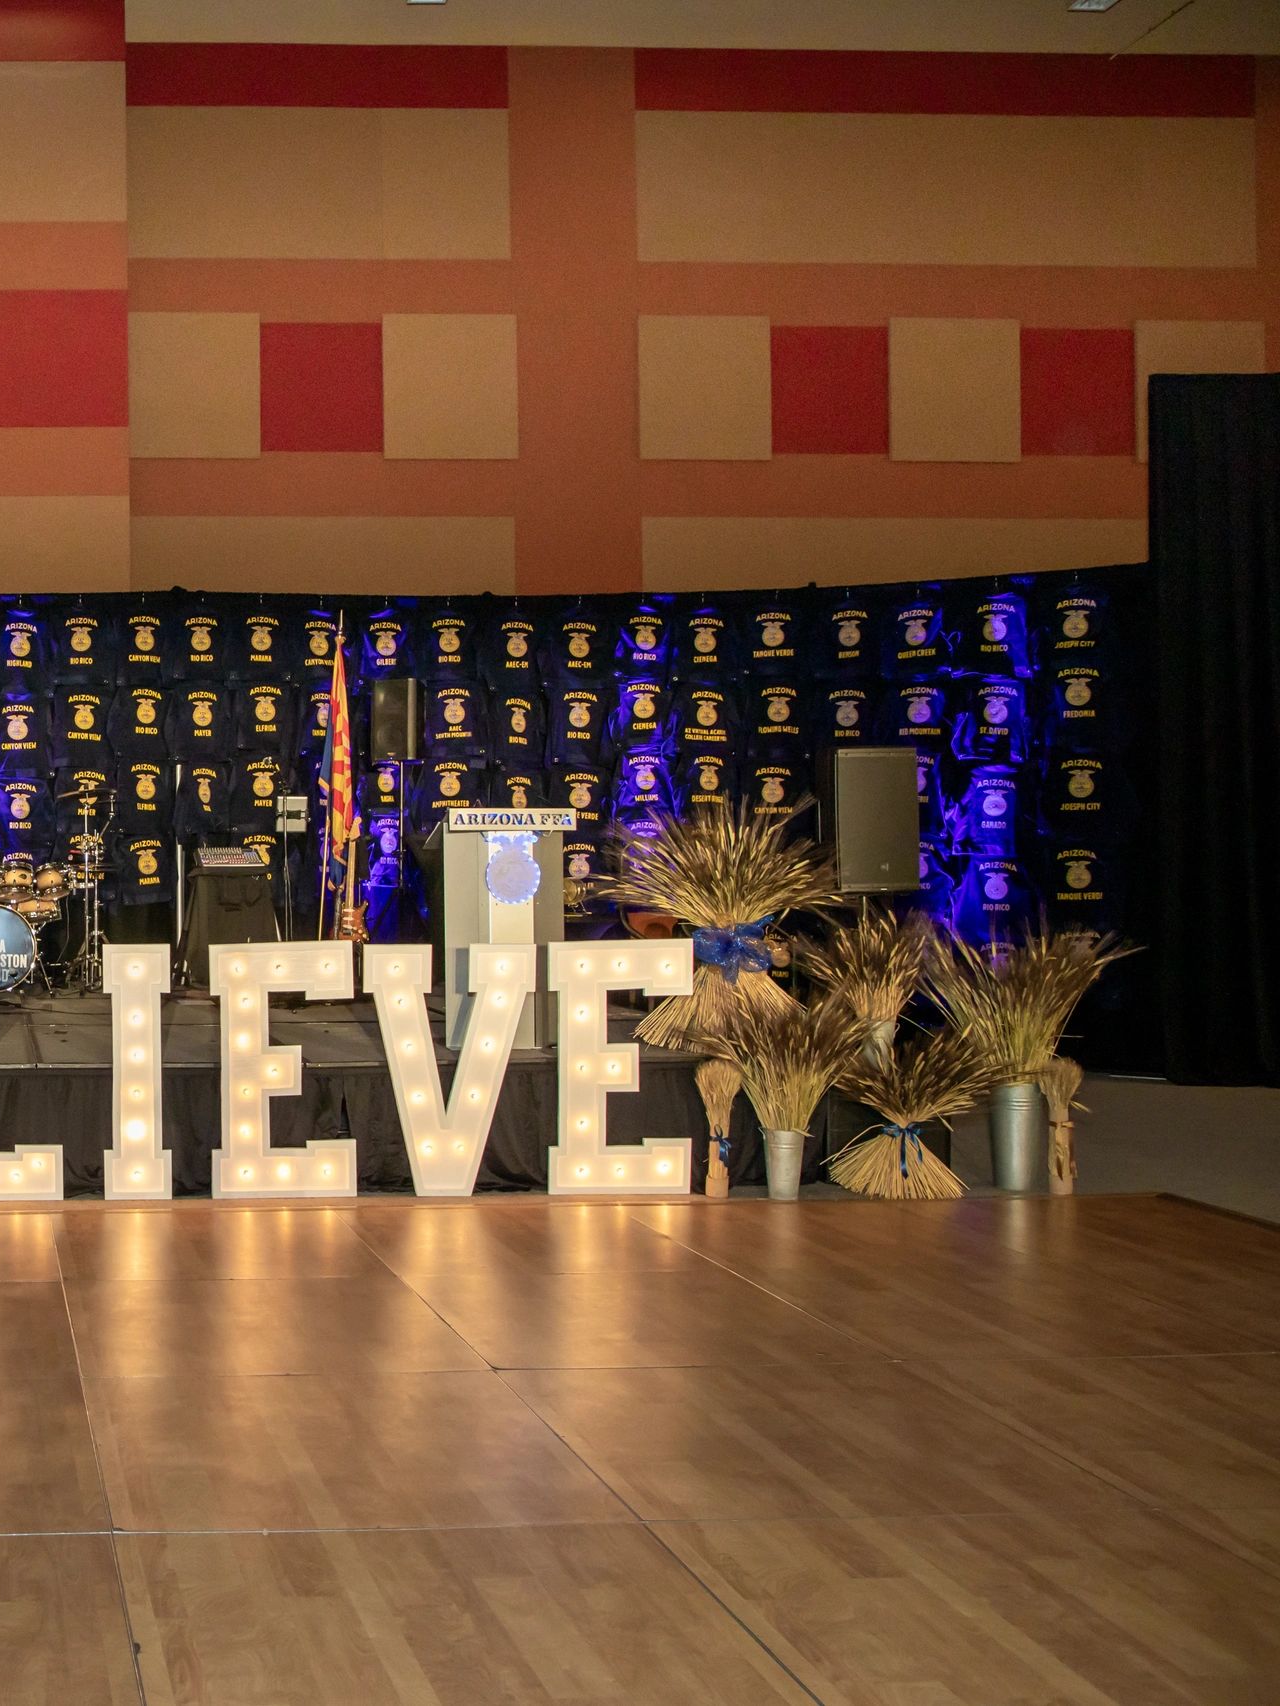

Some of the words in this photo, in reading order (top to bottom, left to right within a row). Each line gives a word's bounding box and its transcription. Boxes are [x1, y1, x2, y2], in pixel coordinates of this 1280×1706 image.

[977, 604, 1015, 613] ARIZONA
[185, 617, 218, 626] ARIZONA
[629, 616, 663, 625] ARIZONA
[755, 613, 791, 622] ARIZONA
[66, 618, 98, 627] ARIZONA
[370, 622, 401, 632] ARIZONA
[502, 621, 533, 632] ARIZONA
[1080, 640, 1095, 648] CITY
[644, 653, 656, 661] RICO
[897, 651, 916, 659] QUEEN
[917, 649, 936, 657] CREEK
[377, 658, 396, 666] GILBERT
[693, 655, 717, 663] CIENEGA
[7, 660, 32, 668] HIGHLAND
[132, 689, 162, 700] ARIZONA
[250, 687, 282, 695] ARIZONA
[829, 690, 866, 699] ARIZONA
[978, 686, 1018, 696] ARIZONA
[564, 691, 597, 702] ARIZONA
[691, 691, 723, 701] ARIZONA
[1, 705, 34, 714] ARIZONA
[1063, 710, 1095, 718] FREDONIA
[782, 726, 799, 734] WELLS
[567, 731, 576, 739] RIO
[629, 756, 660, 765] ARIZONA
[131, 764, 160, 774] ARIZONA
[435, 763, 467, 772] ARIZONA
[755, 767, 791, 776] ARIZONA
[432, 800, 470, 808] AMPHITHEATER
[454, 813, 536, 825] ARIZONA
[540, 813, 572, 825] FFA
[581, 812, 598, 820] VERDE
[981, 821, 1006, 829] GANADO
[1057, 850, 1097, 860] ARIZONA
[139, 877, 160, 885] MARANA
